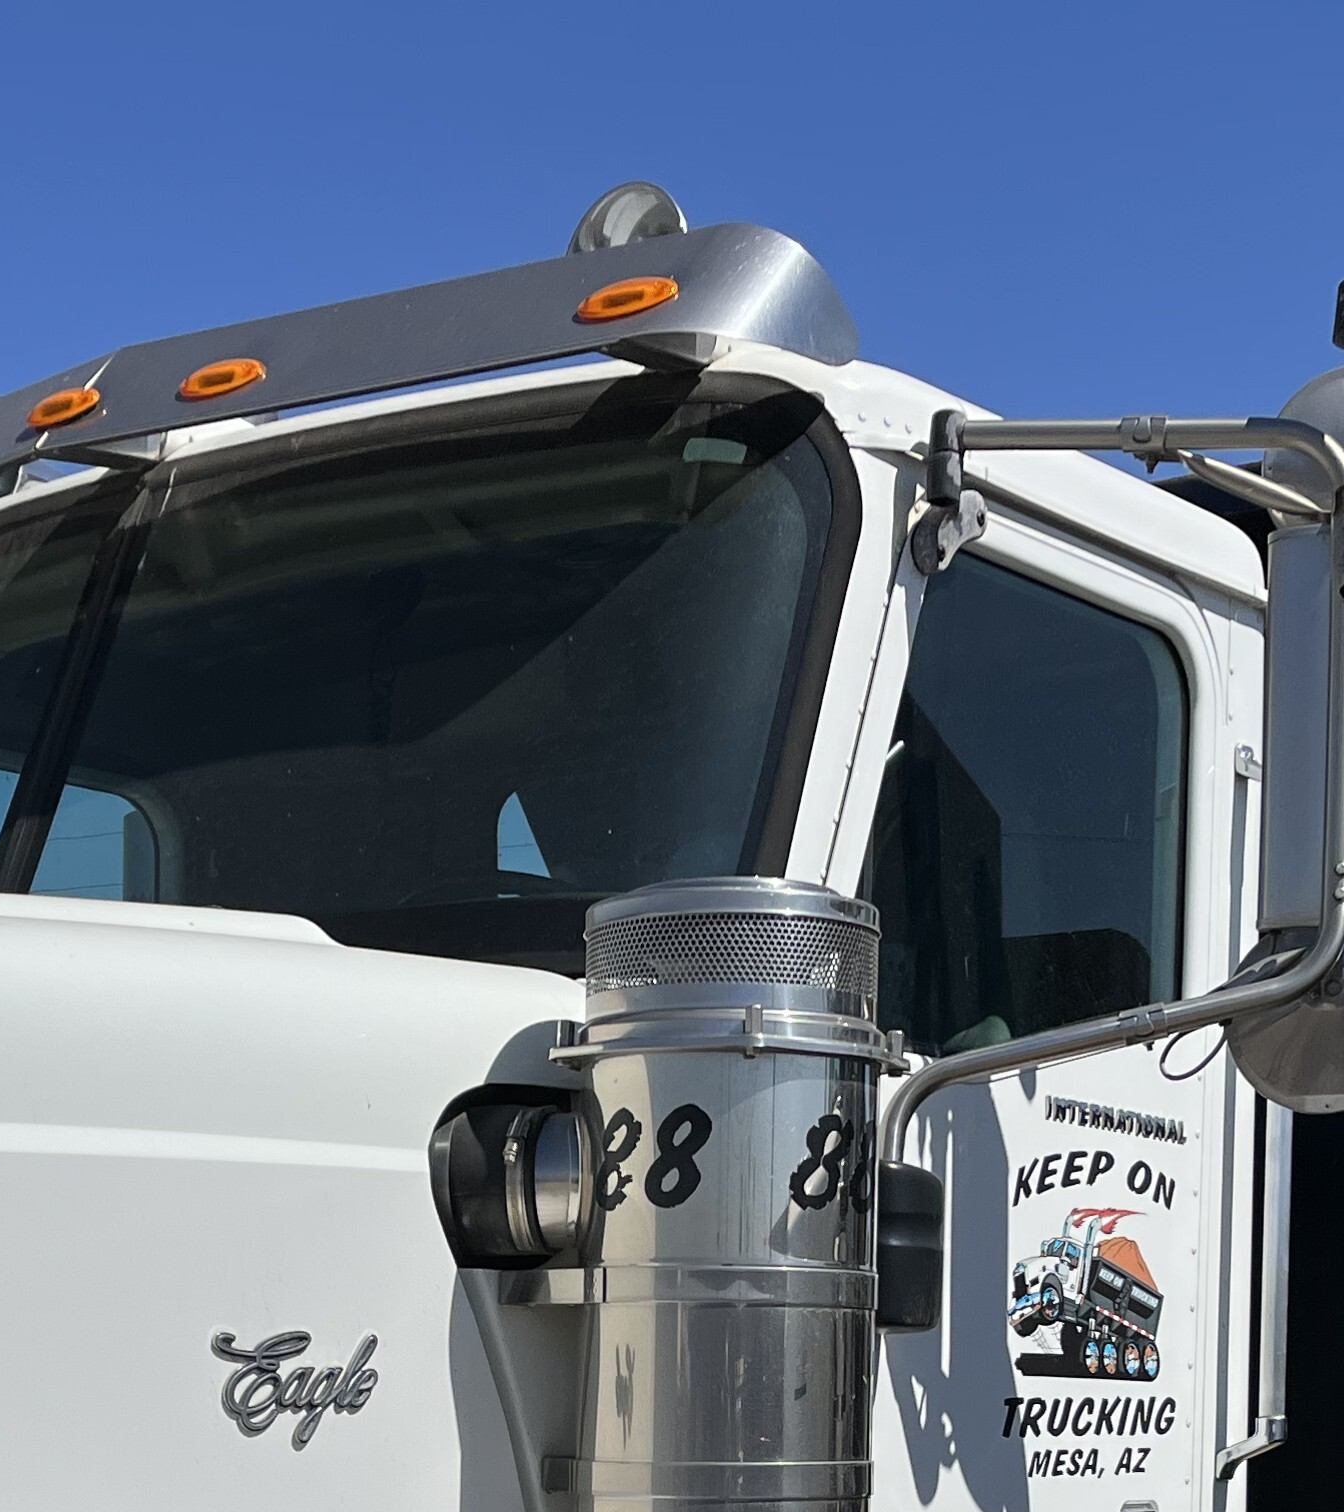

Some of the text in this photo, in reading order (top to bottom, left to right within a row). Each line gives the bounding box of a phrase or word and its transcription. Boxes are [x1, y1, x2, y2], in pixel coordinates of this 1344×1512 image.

[1044, 1095, 1188, 1145] INTERNATIONAL
[596, 1104, 712, 1211] 88
[1012, 1151, 1176, 1210] KEEP ON
[210, 1330, 380, 1452] Eagle
[1002, 1396, 1177, 1438] TRUCKING
[1027, 1447, 1152, 1479] MESA, AZ
